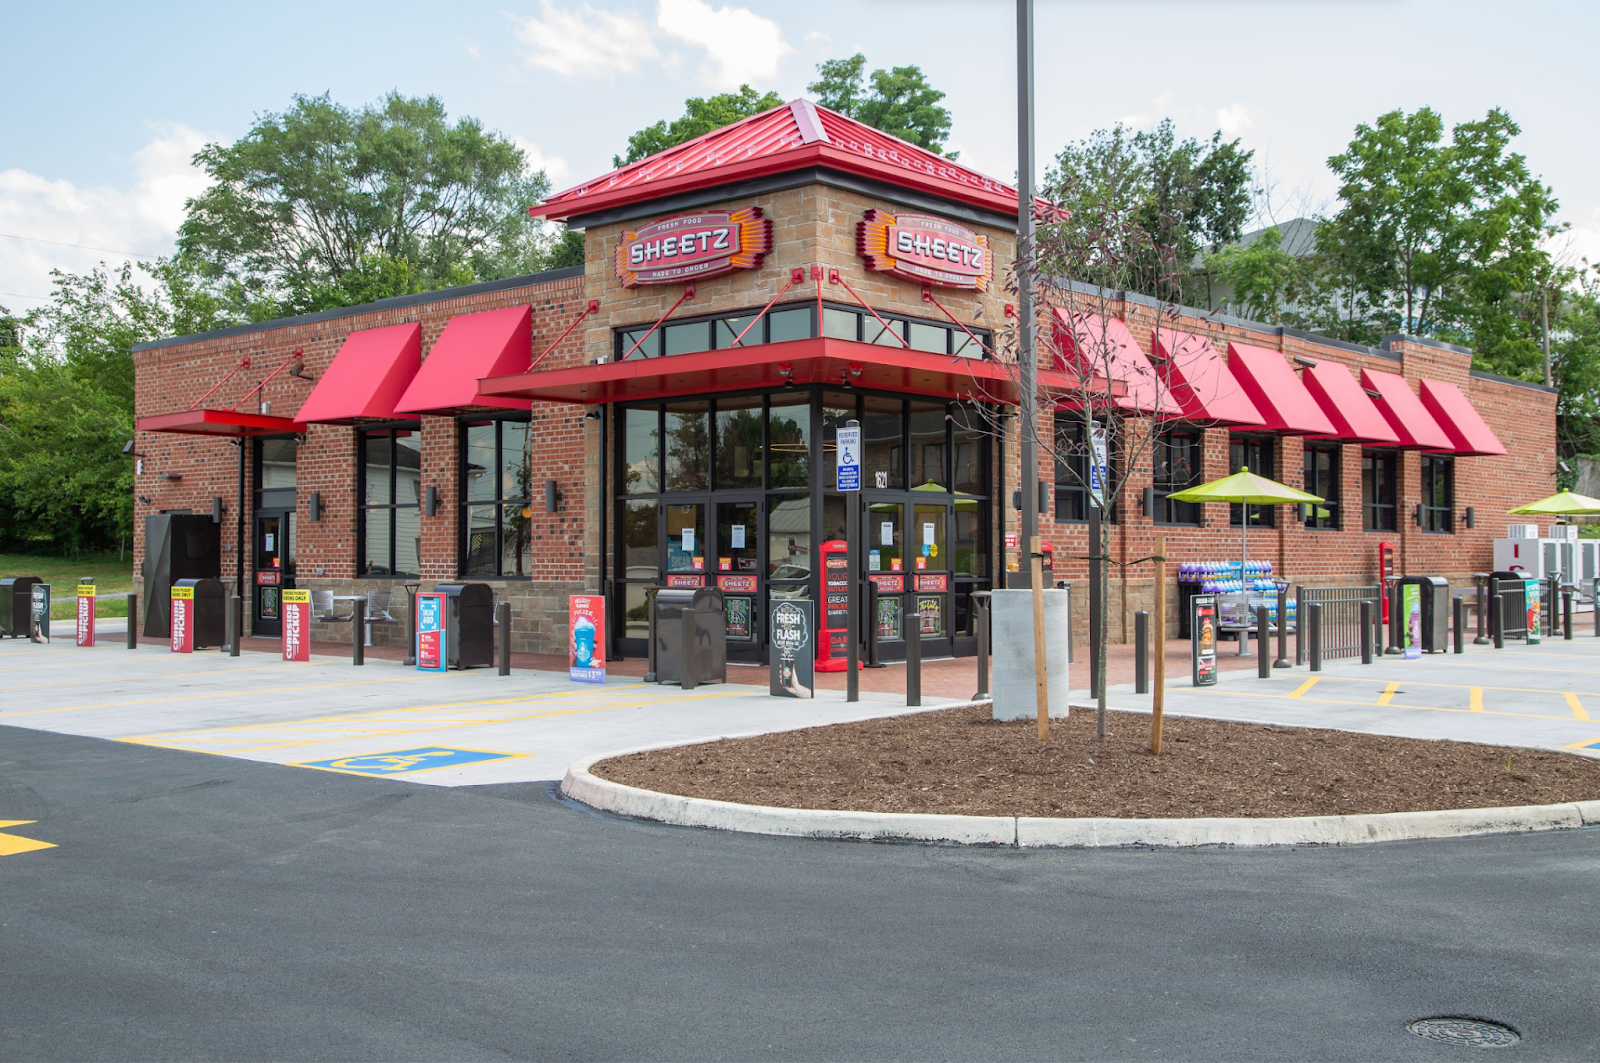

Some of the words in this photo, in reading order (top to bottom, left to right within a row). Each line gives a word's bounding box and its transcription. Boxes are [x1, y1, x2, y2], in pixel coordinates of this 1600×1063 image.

[657, 221, 679, 231] FRESH
[683, 217, 702, 226] FOOD
[921, 221, 941, 229] FRESH
[944, 226, 960, 235] FOOD
[631, 228, 730, 264] SHEETZ
[897, 231, 982, 269] SHEETZ
[652, 269, 671, 277] MADE
[685, 263, 709, 272] ORDER
[914, 266, 932, 275] MADE
[945, 273, 964, 281] ORDER
[875, 471, 888, 488] 1621
[828, 573, 848, 581] YOUR
[574, 609, 594, 617] PUCKER
[776, 613, 801, 624] FRESH
[292, 604, 300, 644] PICKUP
[776, 629, 801, 640] FLASH
[831, 636, 848, 644] DAR
